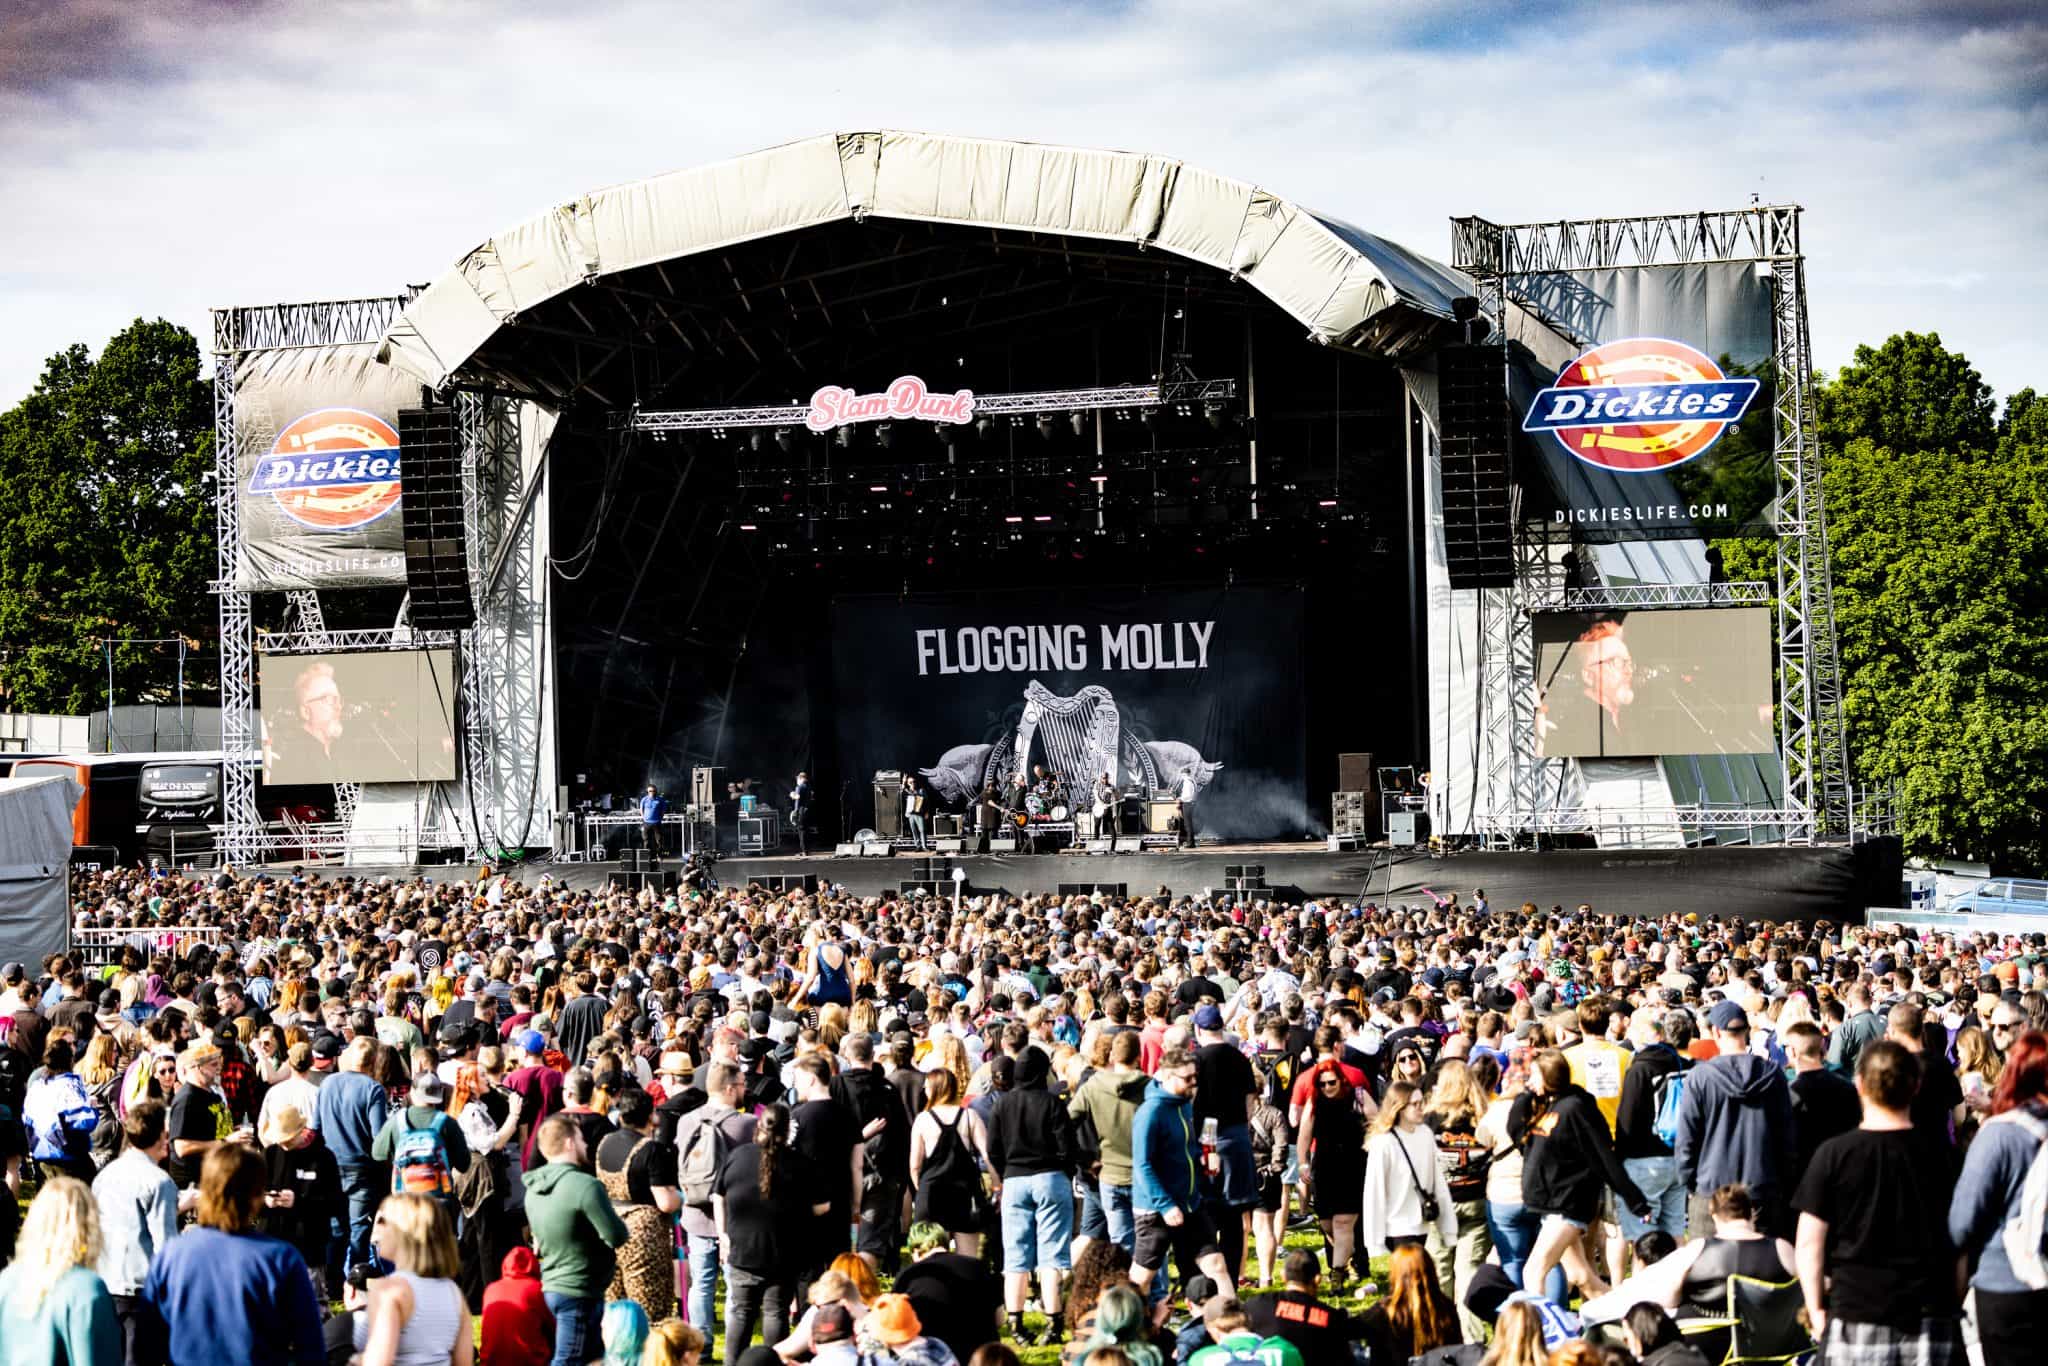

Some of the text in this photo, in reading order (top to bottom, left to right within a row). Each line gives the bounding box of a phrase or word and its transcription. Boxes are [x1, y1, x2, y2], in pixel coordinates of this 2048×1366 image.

[809, 379, 972, 426] Slam Dunk
[1543, 389, 1734, 421] Dickies
[1555, 504, 1729, 523] DICKIESLIFE.COM
[273, 556, 406, 575] DICKIESLIFE.CO
[915, 621, 1217, 676] FLOGGING MOLLY
